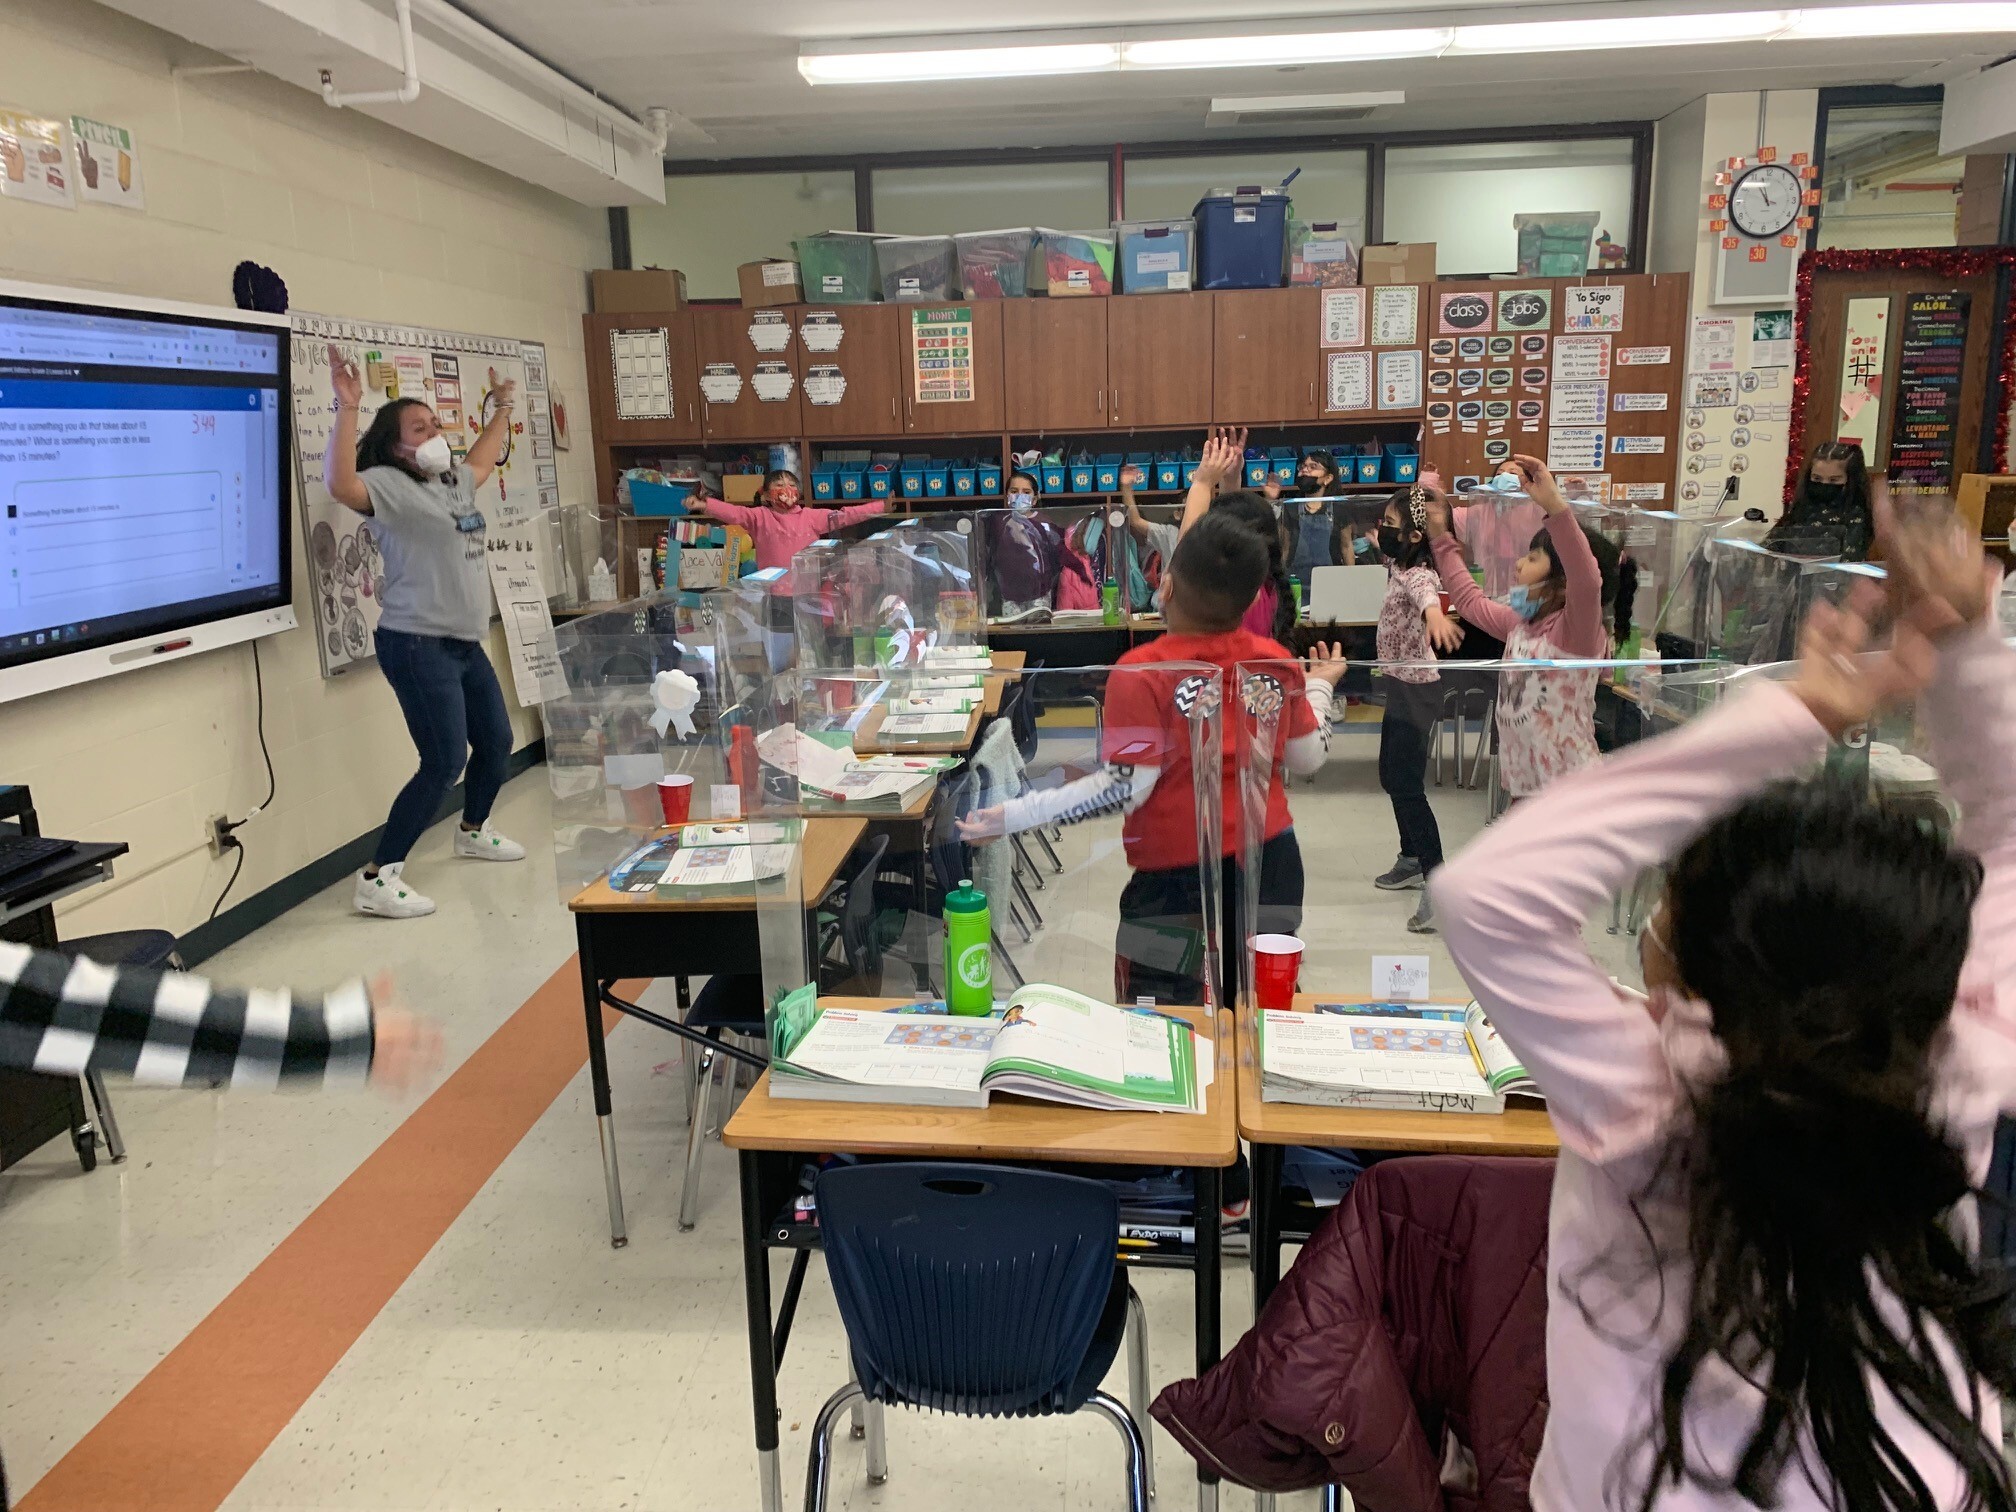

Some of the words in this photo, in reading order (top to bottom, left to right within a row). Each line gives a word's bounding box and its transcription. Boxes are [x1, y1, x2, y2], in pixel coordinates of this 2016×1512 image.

[1766, 168, 1774, 177] 12
[1789, 182, 1795, 191] 2
[1791, 196, 1797, 204] 3
[1738, 212, 1744, 221] 8
[1786, 210, 1791, 218] 4
[1748, 222, 1753, 230] 7
[1761, 225, 1767, 233] 6
[1775, 221, 1780, 229] 5
[1576, 292, 1587, 303] Yo
[1589, 291, 1612, 305] Sigo
[1448, 303, 1485, 318] class
[1507, 300, 1541, 320] jobs
[1584, 305, 1601, 315] Los
[926, 310, 959, 322] MONEY
[1566, 313, 1620, 328] CHAMPS
[307, 403, 324, 417] can
[1905, 424, 1950, 432] LEVANTAMOS
[33, 436, 53, 446] What
[61, 435, 96, 447] something
[1614, 437, 1652, 453] ACTIVIDAD
[18, 451, 27, 461] 15
[1129, 1229, 1159, 1240] EXPO
